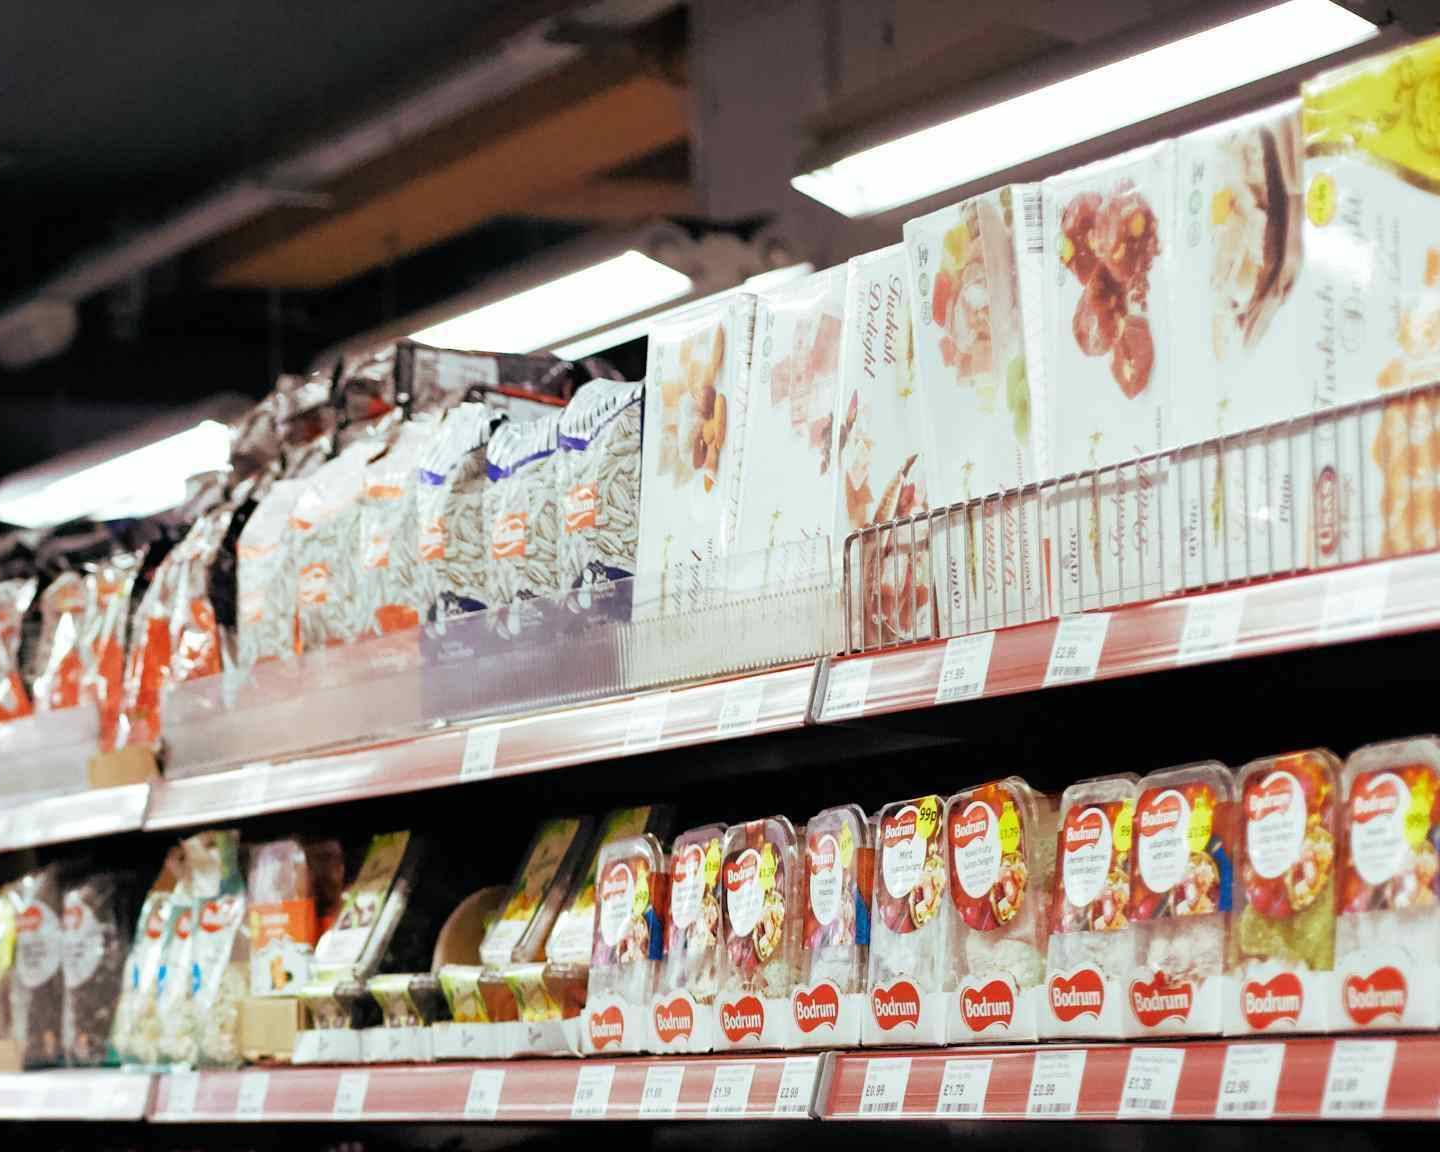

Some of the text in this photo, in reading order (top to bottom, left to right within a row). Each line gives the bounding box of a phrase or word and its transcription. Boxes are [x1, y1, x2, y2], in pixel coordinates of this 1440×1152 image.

[863, 281, 880, 380] Delight
[884, 273, 902, 366] Turkish
[919, 806, 937, 824] 99p
[885, 821, 915, 838] Bodrum
[954, 819, 988, 839] Bodrum
[796, 998, 837, 1020] Bodrum
[873, 996, 918, 1018] Bodrum
[965, 997, 1012, 1019] Bodrum
[1052, 985, 1103, 1011] Bodrum
[1135, 990, 1191, 1014] Bodrum
[1246, 988, 1301, 1015] Bodrum
[1347, 984, 1405, 1012] Bodrum
[656, 1011, 692, 1031] Bodrum
[724, 1011, 761, 1033] Bodrum
